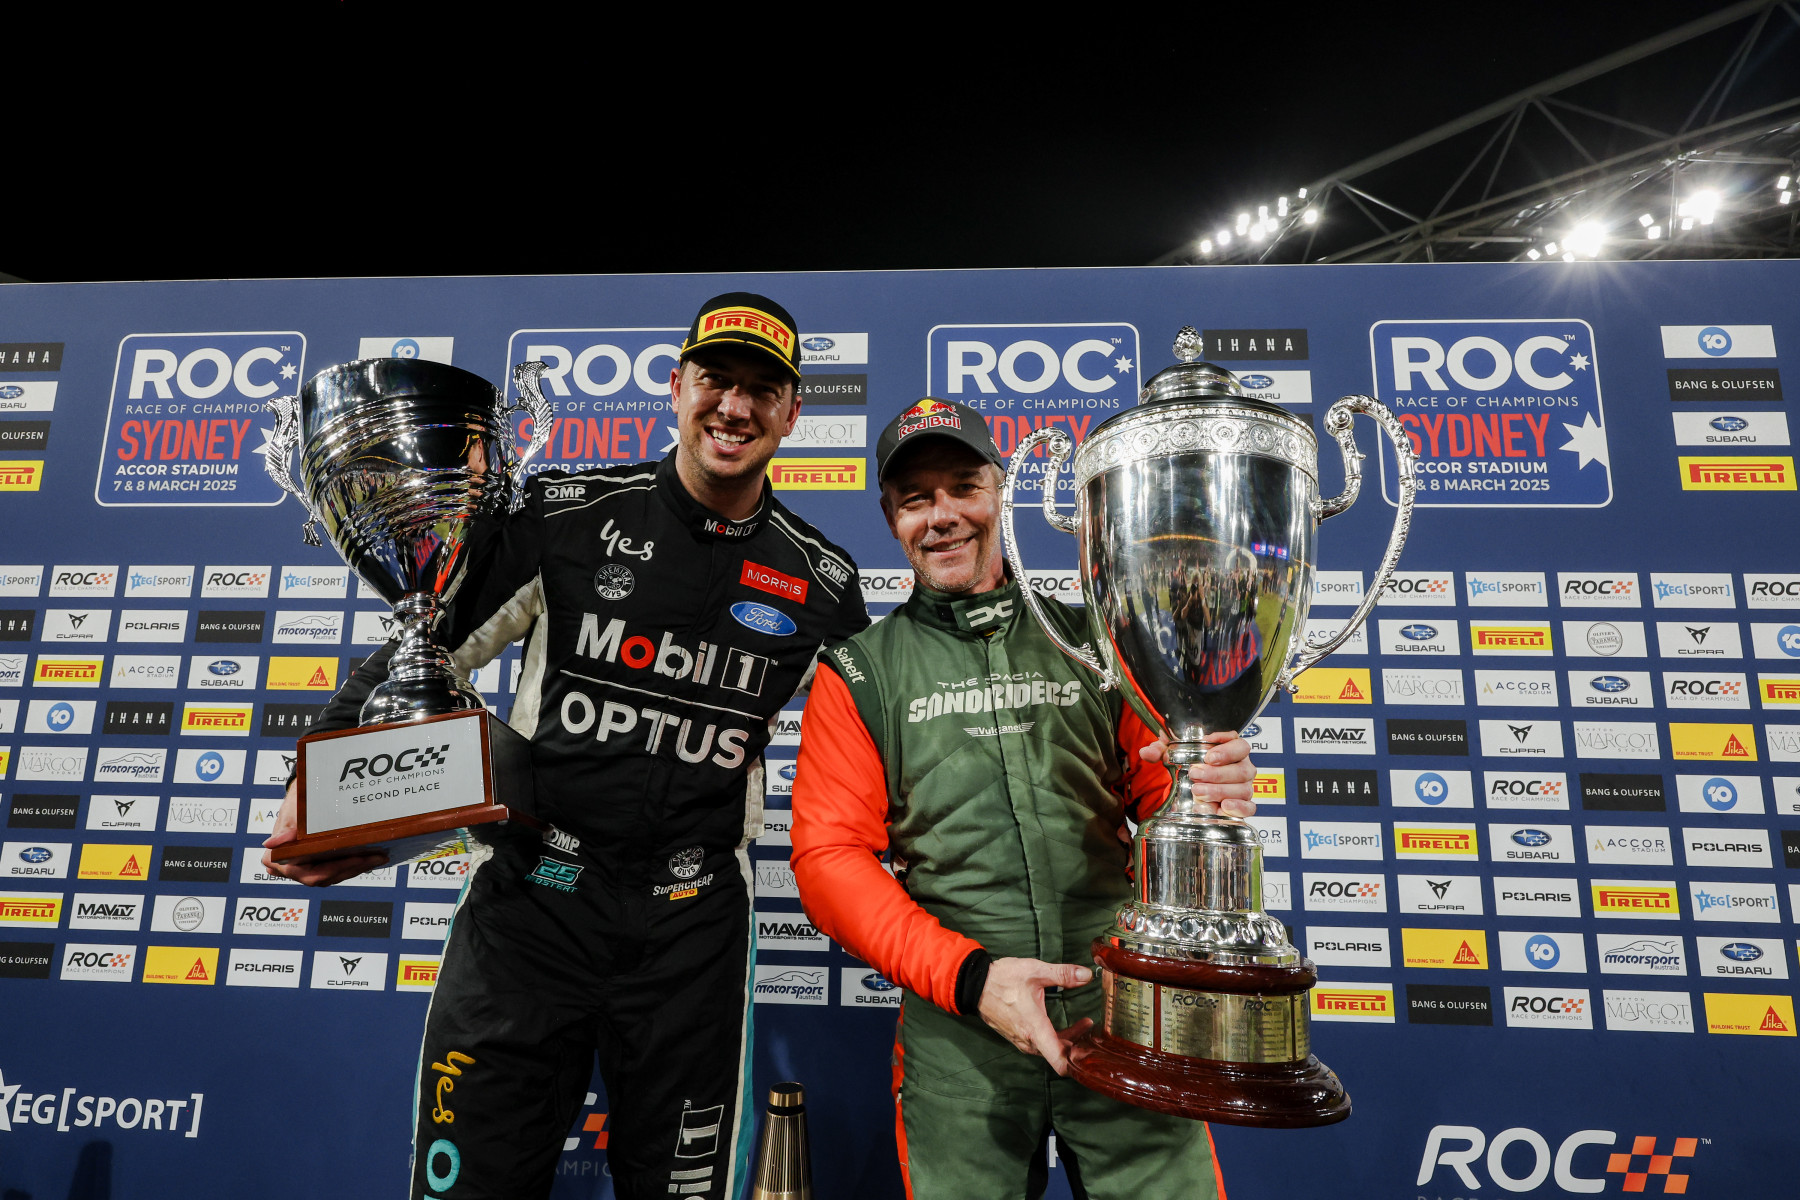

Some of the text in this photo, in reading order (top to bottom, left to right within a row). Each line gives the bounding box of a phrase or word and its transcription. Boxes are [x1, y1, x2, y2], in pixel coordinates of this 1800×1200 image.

[704, 310, 790, 350] PIRELLI
[1218, 338, 1293, 351] IHANA
[1703, 334, 1726, 350] 10
[0, 351, 50, 363] HANA
[1392, 335, 1573, 392] ROC
[129, 346, 283, 399] ROC
[948, 340, 1118, 393] ROC
[815, 385, 861, 394] OLUFSEN
[1675, 380, 1773, 390] BANG & OLUFSEN
[126, 403, 270, 415] RACE OF CHAMPION
[567, 400, 672, 412] OF CHAMPION
[1000, 399, 1119, 409] OF CHAMPIONS
[1396, 396, 1579, 408] RACE OF CHAMPIONS
[899, 414, 961, 440] Red Bull
[2, 432, 44, 440] OLUFSEN
[118, 419, 250, 460] SYDNEY
[1400, 413, 1549, 458] SYDNEY
[1706, 435, 1756, 443] SUBARU
[116, 464, 238, 475] ACCOR STADIUM
[772, 465, 857, 483] PIRELLI
[1414, 462, 1548, 473] CCOR STADIUM
[1690, 464, 1785, 484] PIRELLI
[114, 480, 237, 491] 7 & 8 MARCH 2025
[1430, 479, 1439, 491] 8
[1444, 479, 1506, 491] MARCH
[1509, 479, 1550, 491] 2025
[545, 486, 586, 499] OMP
[705, 519, 742, 537] Mobil
[599, 566, 631, 585] CHEMICAL
[818, 558, 849, 584] OMP
[56, 572, 95, 586] ROC
[747, 569, 802, 595] MORRIS
[860, 576, 898, 590] ROC
[601, 587, 622, 597] GUYS
[1565, 580, 1614, 595] ROC
[125, 622, 180, 630] POLARIS
[744, 608, 782, 632] Ford
[278, 628, 338, 640] motorsport
[1478, 631, 1544, 646] PIRELLI
[575, 612, 718, 685] Mobil
[41, 665, 96, 678] PIRELLI
[834, 647, 865, 684] Sabelt
[937, 677, 978, 690] THE
[1386, 679, 1461, 696] MARGOT
[1496, 682, 1550, 691] ACCOR
[1671, 680, 1720, 695] ROC
[908, 680, 1081, 723] SANDRIDERS
[52, 710, 69, 724] 10
[561, 691, 749, 769] OPTUS
[977, 724, 1022, 735] Vulcanet
[1426, 734, 1463, 742] OLUFSEN
[1577, 732, 1655, 750] MARGOT
[339, 749, 418, 782] ROC
[339, 768, 445, 791] RACE OF CHAMPIONS
[352, 782, 440, 804] SECOND PLACE
[1305, 781, 1371, 794] IHANA
[535, 859, 579, 882] 25
[653, 874, 713, 896] SUPERCHEAP
[672, 890, 695, 898] AUTO
[1600, 891, 1669, 908] PIRELLI
[323, 915, 388, 924] BANG & OLUFSEN
[67, 953, 110, 967] ROC
[1605, 955, 1679, 969] motorsport
[1717, 966, 1772, 975] SUBARU
[755, 985, 824, 999] motorsport
[856, 996, 902, 1004] SUBARU
[1412, 1001, 1487, 1010] BANG & OLUFSEN
[1512, 996, 1563, 1013] ROC
[1606, 1002, 1688, 1021] MARGOT
[1416, 1125, 1617, 1194] ROC
